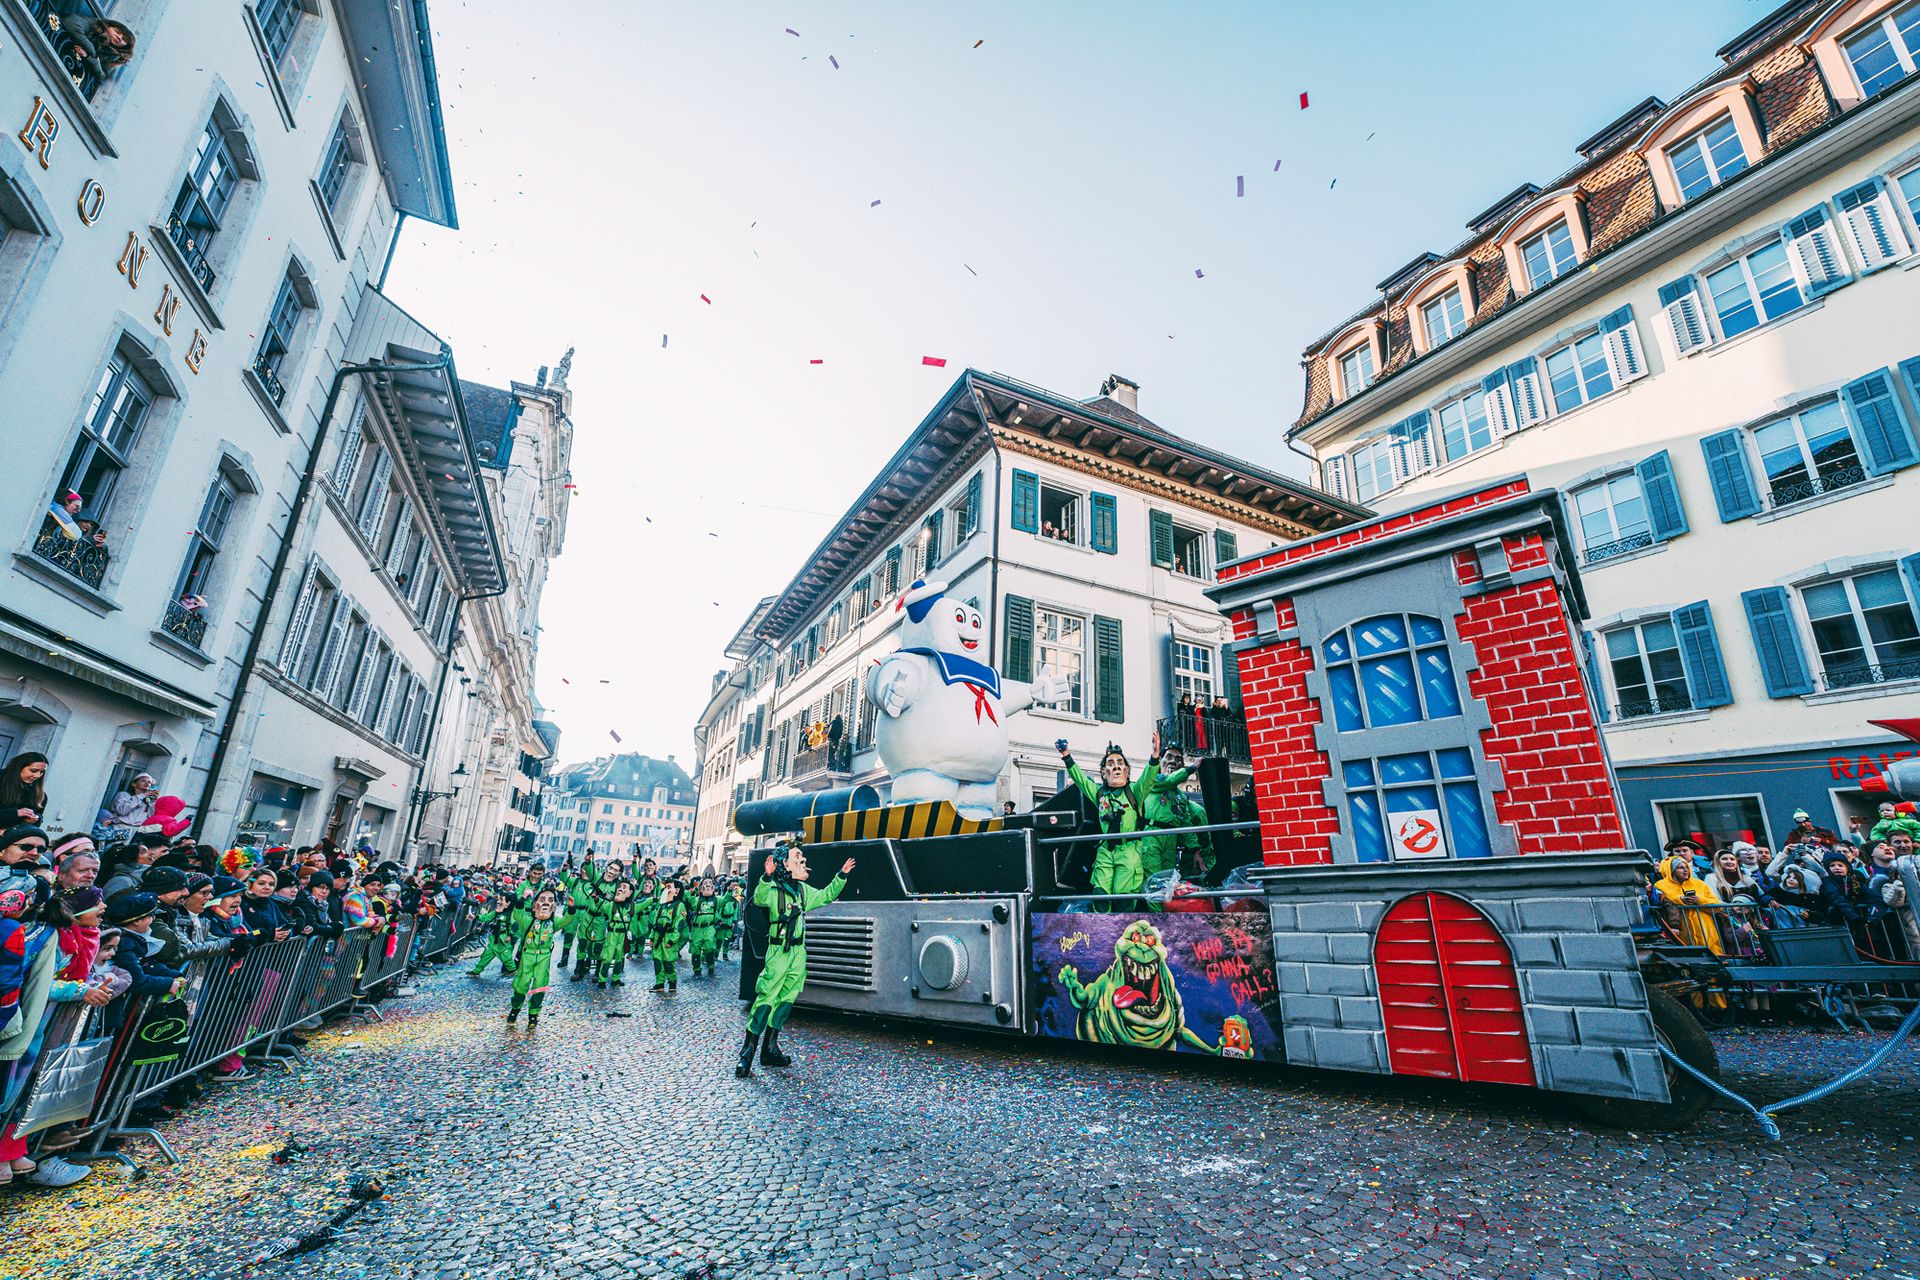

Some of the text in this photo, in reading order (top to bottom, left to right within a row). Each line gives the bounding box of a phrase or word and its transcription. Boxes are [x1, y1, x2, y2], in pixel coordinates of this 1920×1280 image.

[18, 95, 209, 375] RONNE
[1828, 750, 1920, 780] RAI
[1185, 784, 1201, 793] Caf
[1192, 927, 1253, 962] WHO YA
[1205, 954, 1251, 985] GONNA
[1230, 968, 1275, 1009] CALL?
